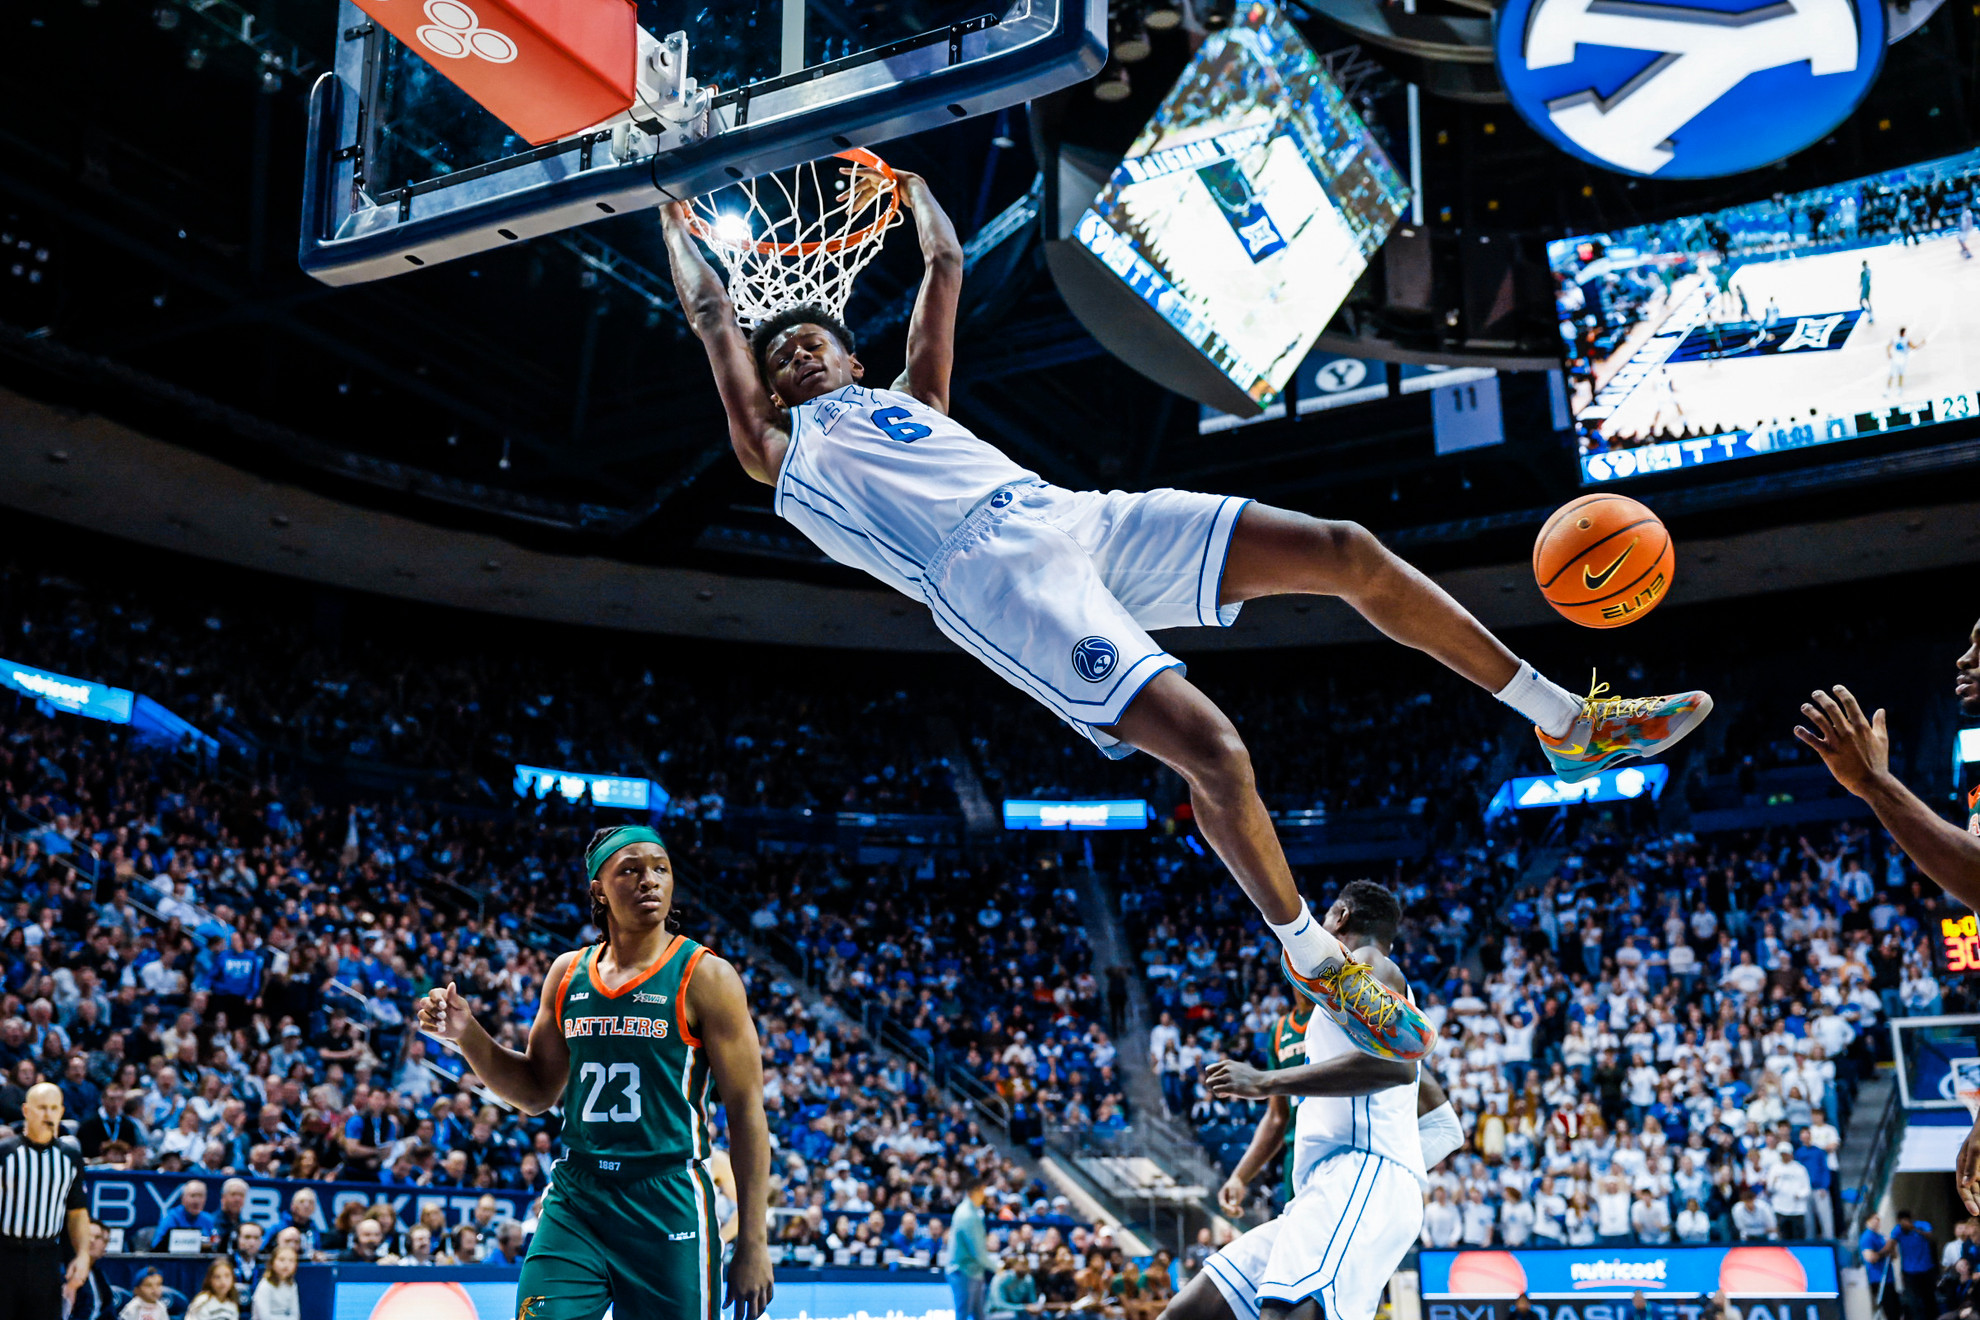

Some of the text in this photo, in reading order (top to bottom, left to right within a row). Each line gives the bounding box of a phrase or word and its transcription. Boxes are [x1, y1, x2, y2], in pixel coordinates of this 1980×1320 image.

[1526, 0, 1858, 175] Y
[1453, 386, 1477, 412] 11
[1943, 396, 1970, 417] 23
[871, 406, 932, 443] 6
[1600, 571, 1666, 619] ELITE
[564, 1016, 669, 1039] RATTLERS
[580, 1062, 641, 1122] 23
[598, 1160, 622, 1171] 1887
[92, 1180, 186, 1228] BY
[1570, 1258, 1668, 1281] nutricost
